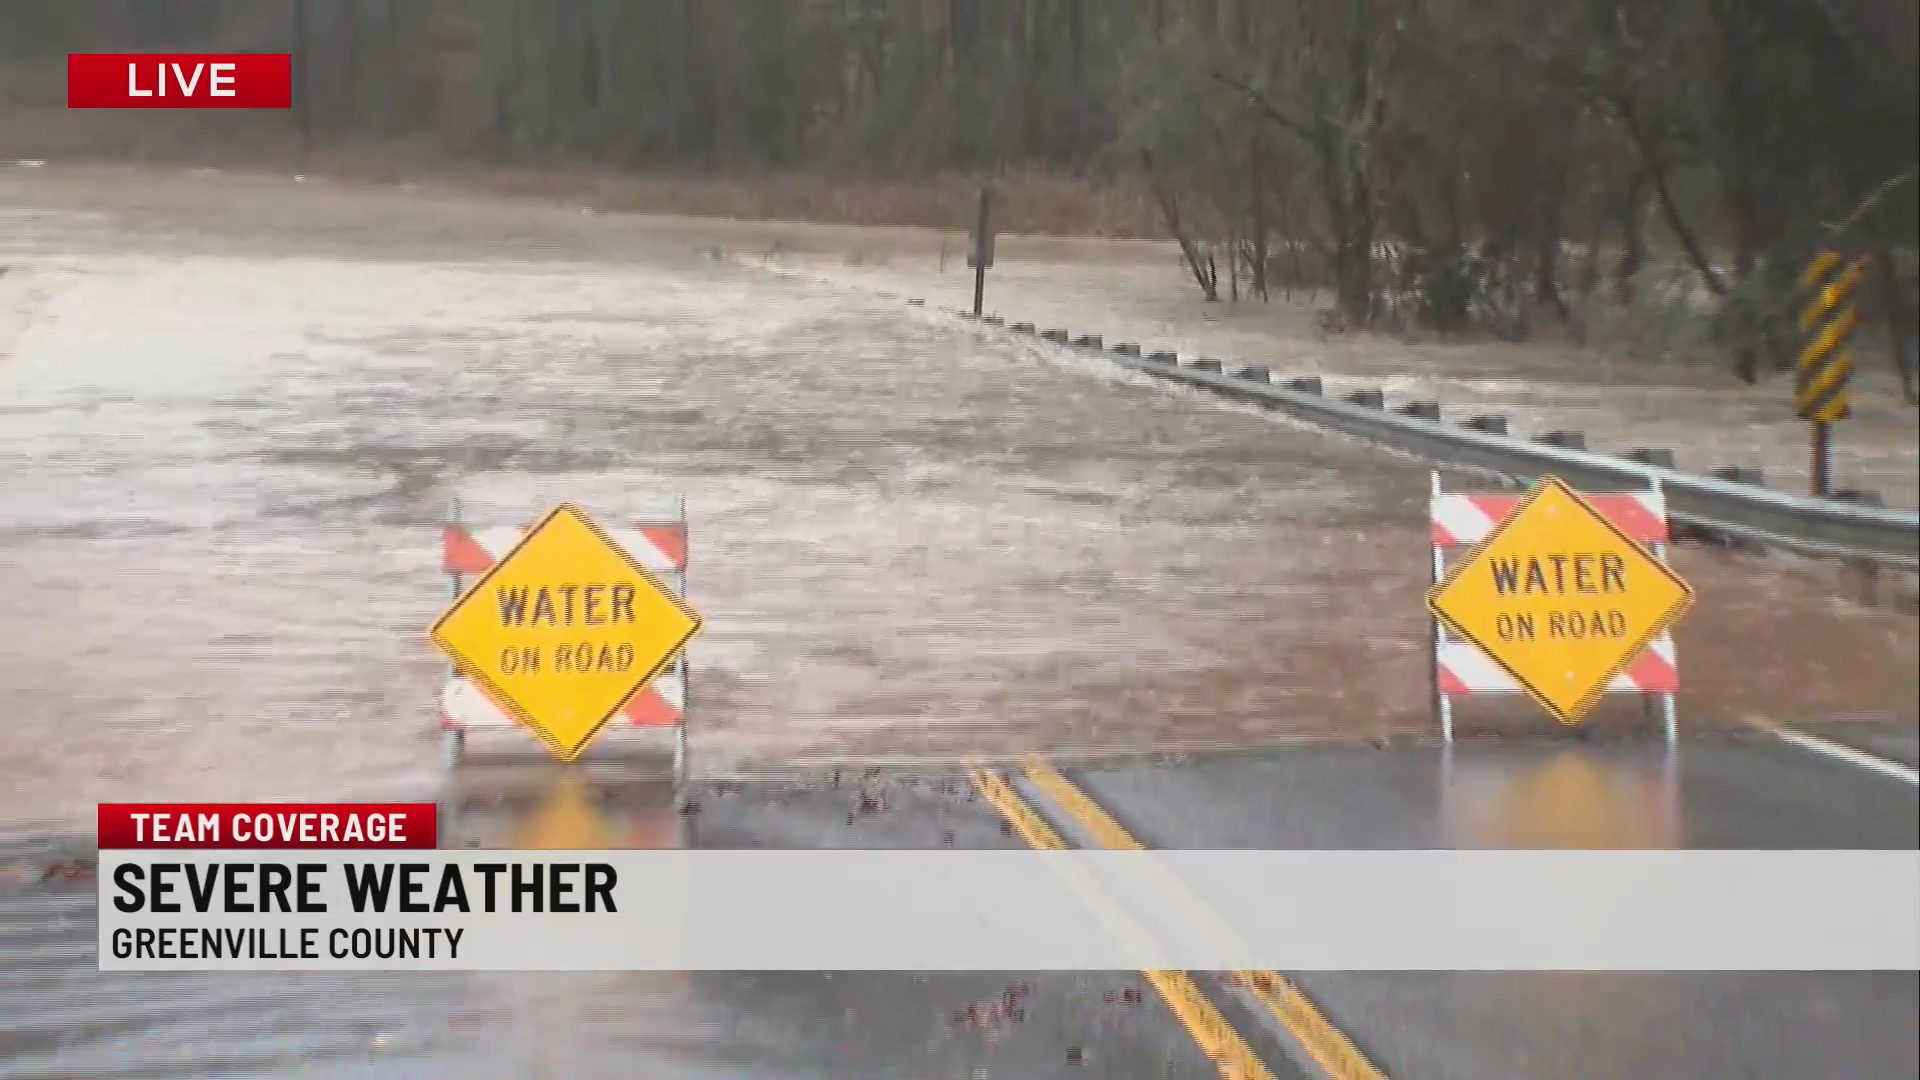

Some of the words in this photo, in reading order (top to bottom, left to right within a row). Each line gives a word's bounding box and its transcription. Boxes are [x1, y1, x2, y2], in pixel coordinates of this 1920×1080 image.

[1490, 552, 1627, 595] WATER
[497, 582, 637, 627] WATER
[1496, 612, 1536, 642] ON
[1549, 609, 1628, 639] ROAD
[500, 645, 541, 675] ON
[554, 642, 635, 673] ROAD
